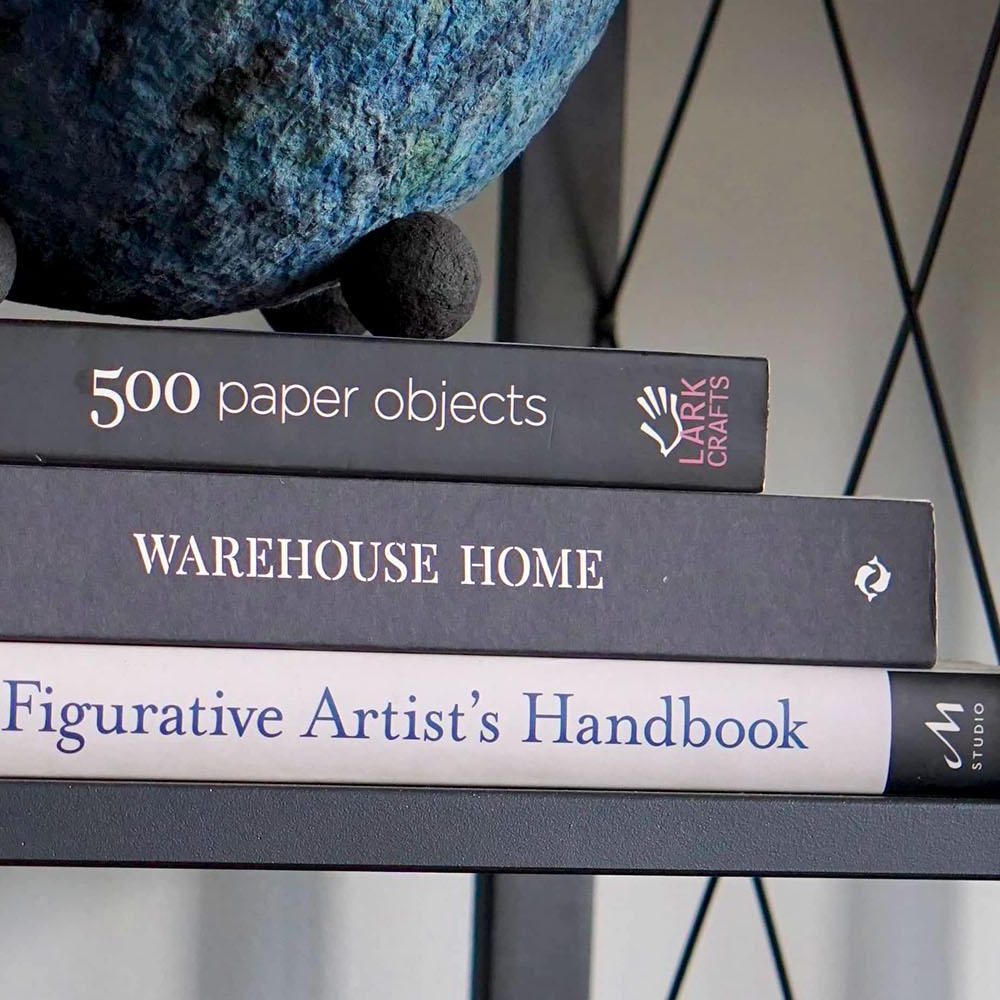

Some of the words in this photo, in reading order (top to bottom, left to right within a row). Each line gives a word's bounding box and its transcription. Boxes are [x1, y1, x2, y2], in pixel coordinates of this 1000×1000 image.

[90, 365, 200, 428] 500
[217, 379, 360, 424] paper
[374, 377, 548, 431] objects
[678, 377, 707, 465] LARK
[707, 375, 730, 467] CRAFTS
[133, 532, 440, 584] WAREHOUSE
[460, 544, 604, 589] HOME
[1, 679, 284, 754] Figurative
[299, 686, 500, 744] Artist's
[521, 692, 809, 750] Handbook
[971, 702, 986, 771] STUDIO
